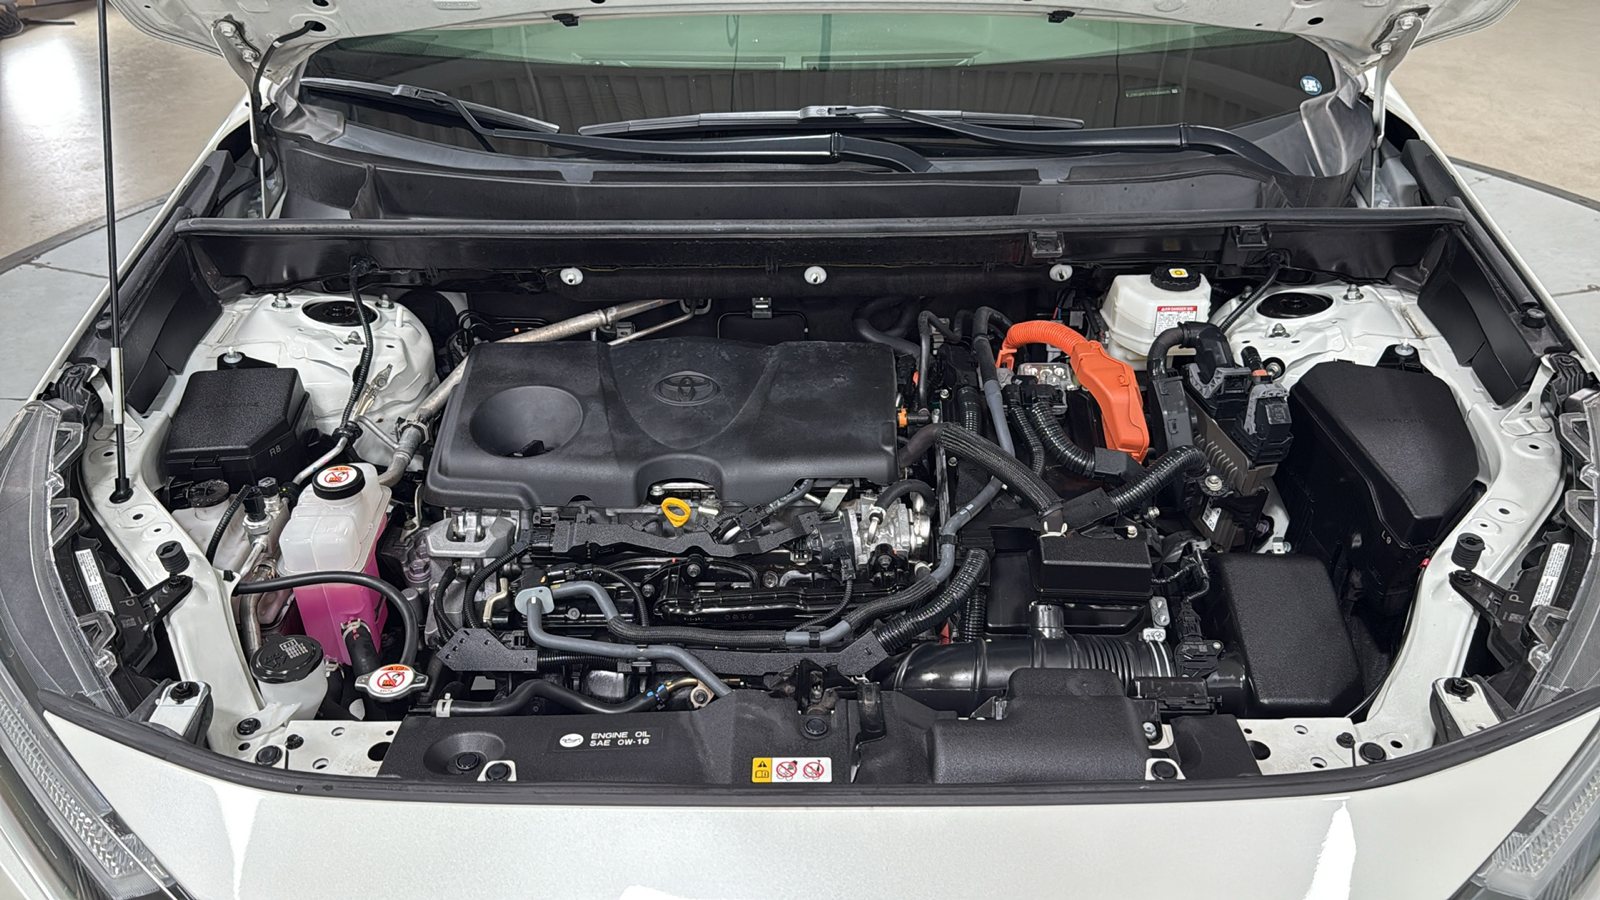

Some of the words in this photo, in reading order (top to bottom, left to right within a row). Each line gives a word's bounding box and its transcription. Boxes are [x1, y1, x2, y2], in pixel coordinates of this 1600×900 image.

[269, 444, 281, 457] R8
[590, 731, 629, 740] ENGINE
[634, 730, 651, 738] OIL
[589, 739, 611, 747] SAE
